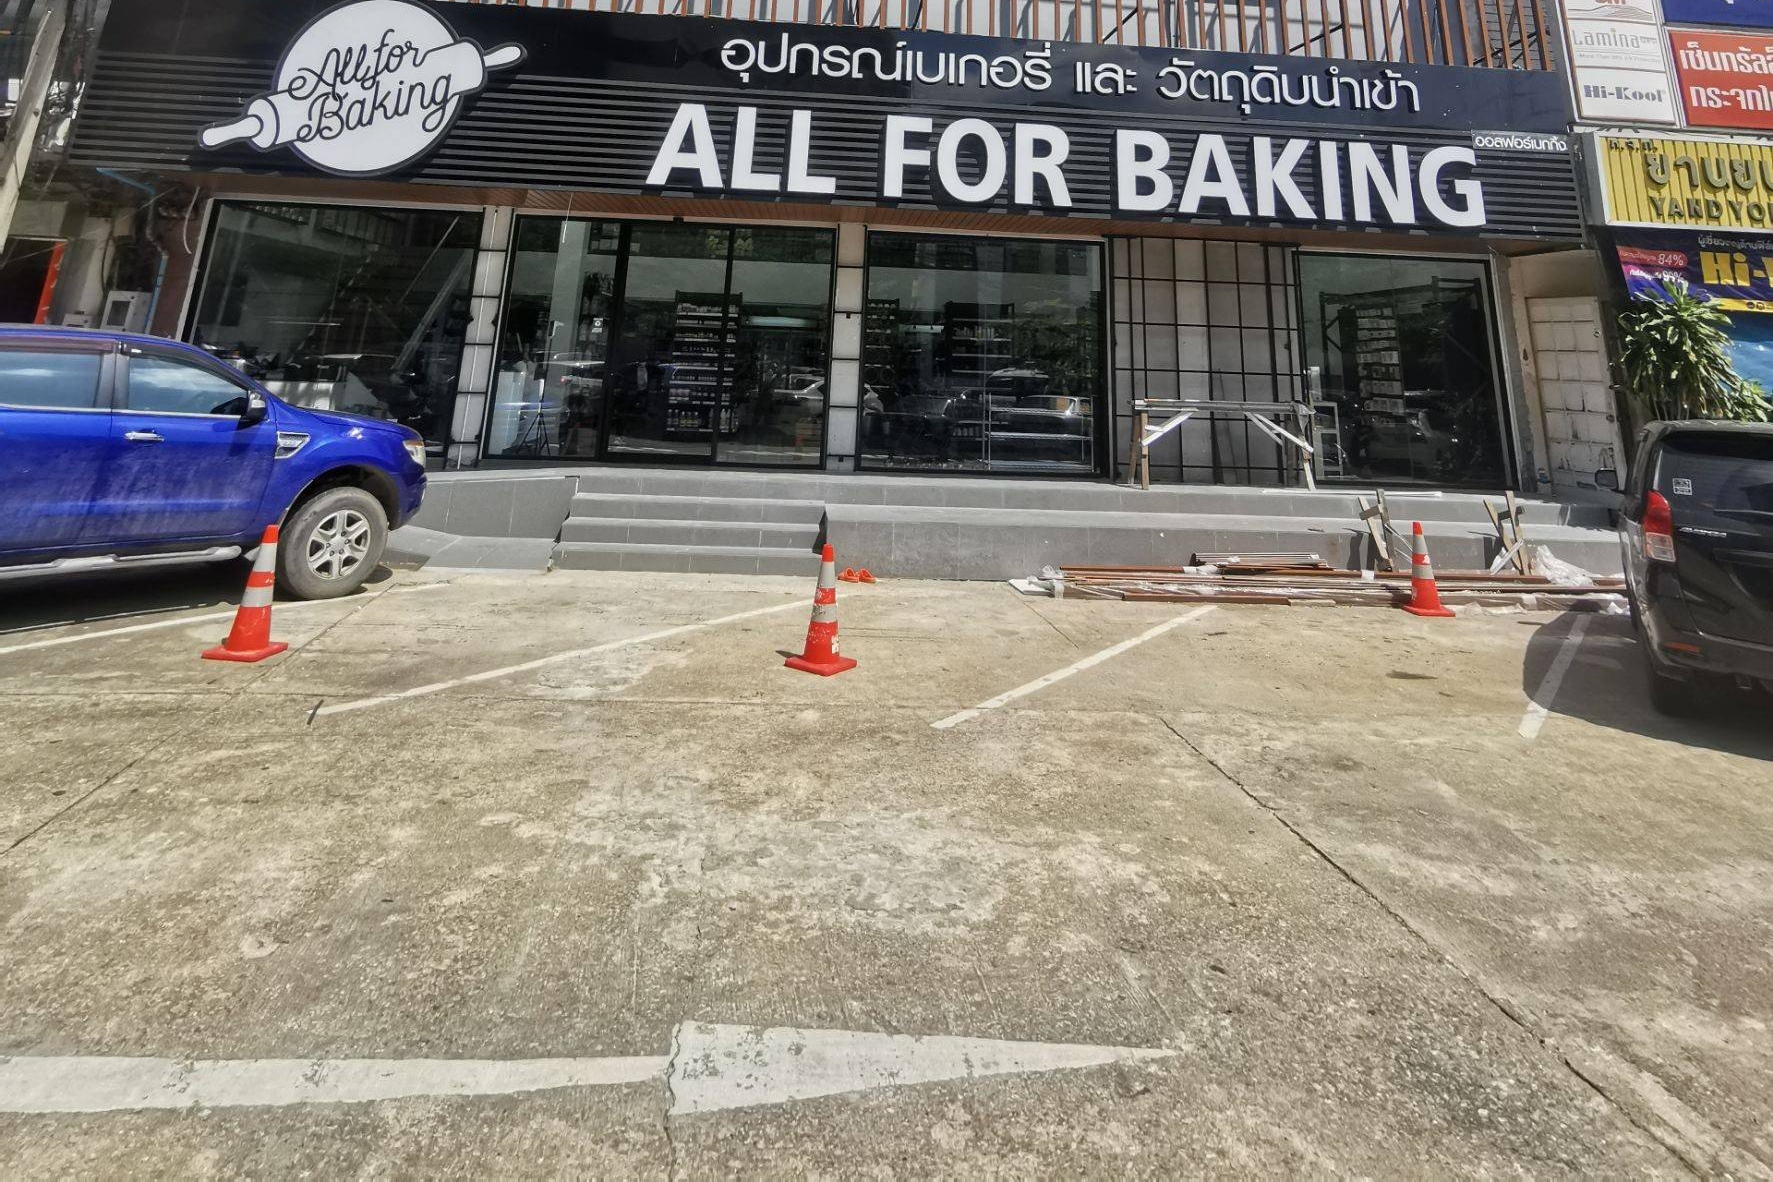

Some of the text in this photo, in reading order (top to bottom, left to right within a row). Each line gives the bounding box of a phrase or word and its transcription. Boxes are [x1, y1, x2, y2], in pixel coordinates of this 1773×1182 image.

[1572, 27, 1641, 49] Lamina
[721, 32, 1420, 115] อุปกรณ์เบเกอรี่ และ วัตถุดิบนำเข้า
[1583, 84, 1663, 103] Hi-Kool
[1689, 84, 1773, 112] กระจกไ
[296, 74, 452, 143] Baking
[645, 103, 1487, 228] ALL FOR BAKING
[1657, 253, 1684, 266] 84%
